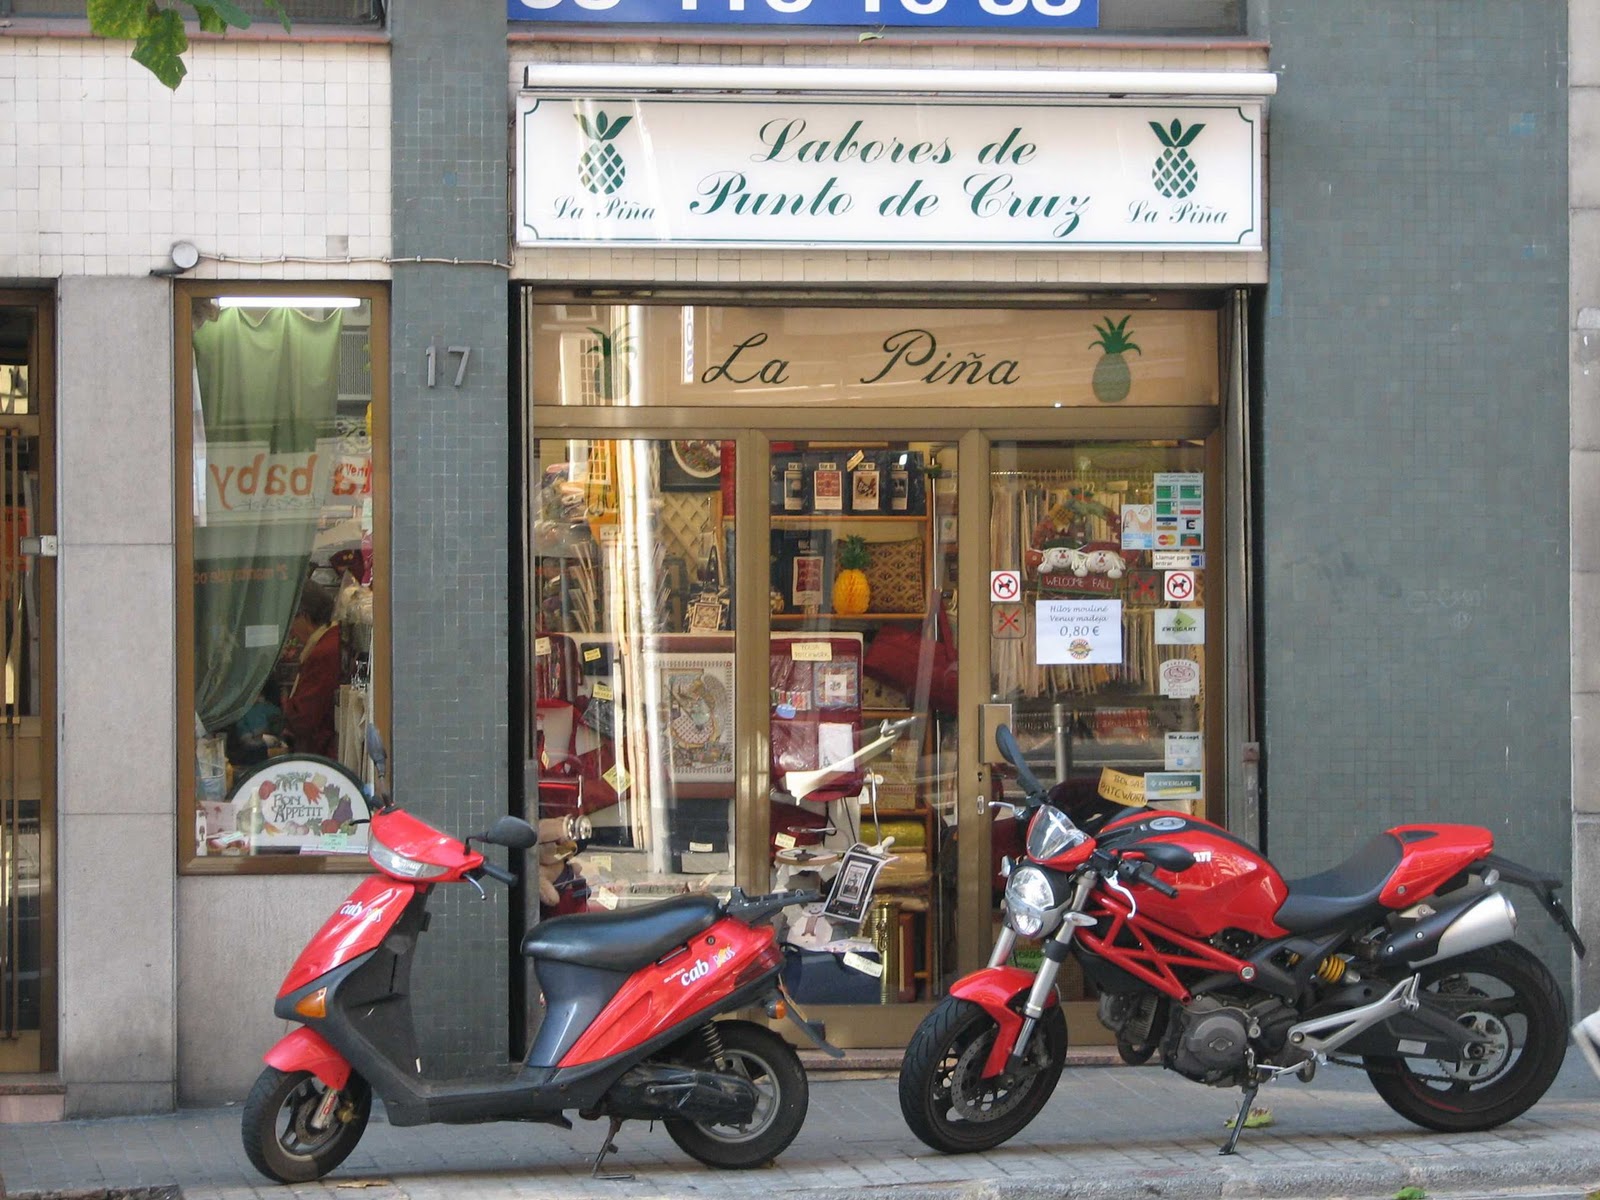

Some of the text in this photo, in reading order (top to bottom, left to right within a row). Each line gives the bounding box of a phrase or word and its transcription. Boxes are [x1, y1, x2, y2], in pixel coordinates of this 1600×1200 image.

[749, 117, 1037, 165] Labores de
[553, 195, 656, 220] La Piña
[690, 170, 1091, 238] Punto de Cruz
[1126, 200, 1228, 223] La Piña
[426, 346, 470, 387] 17
[701, 332, 790, 384] La
[860, 329, 1020, 385] Piña
[1059, 625, 1089, 637] 0,80
[681, 958, 709, 987] cab
